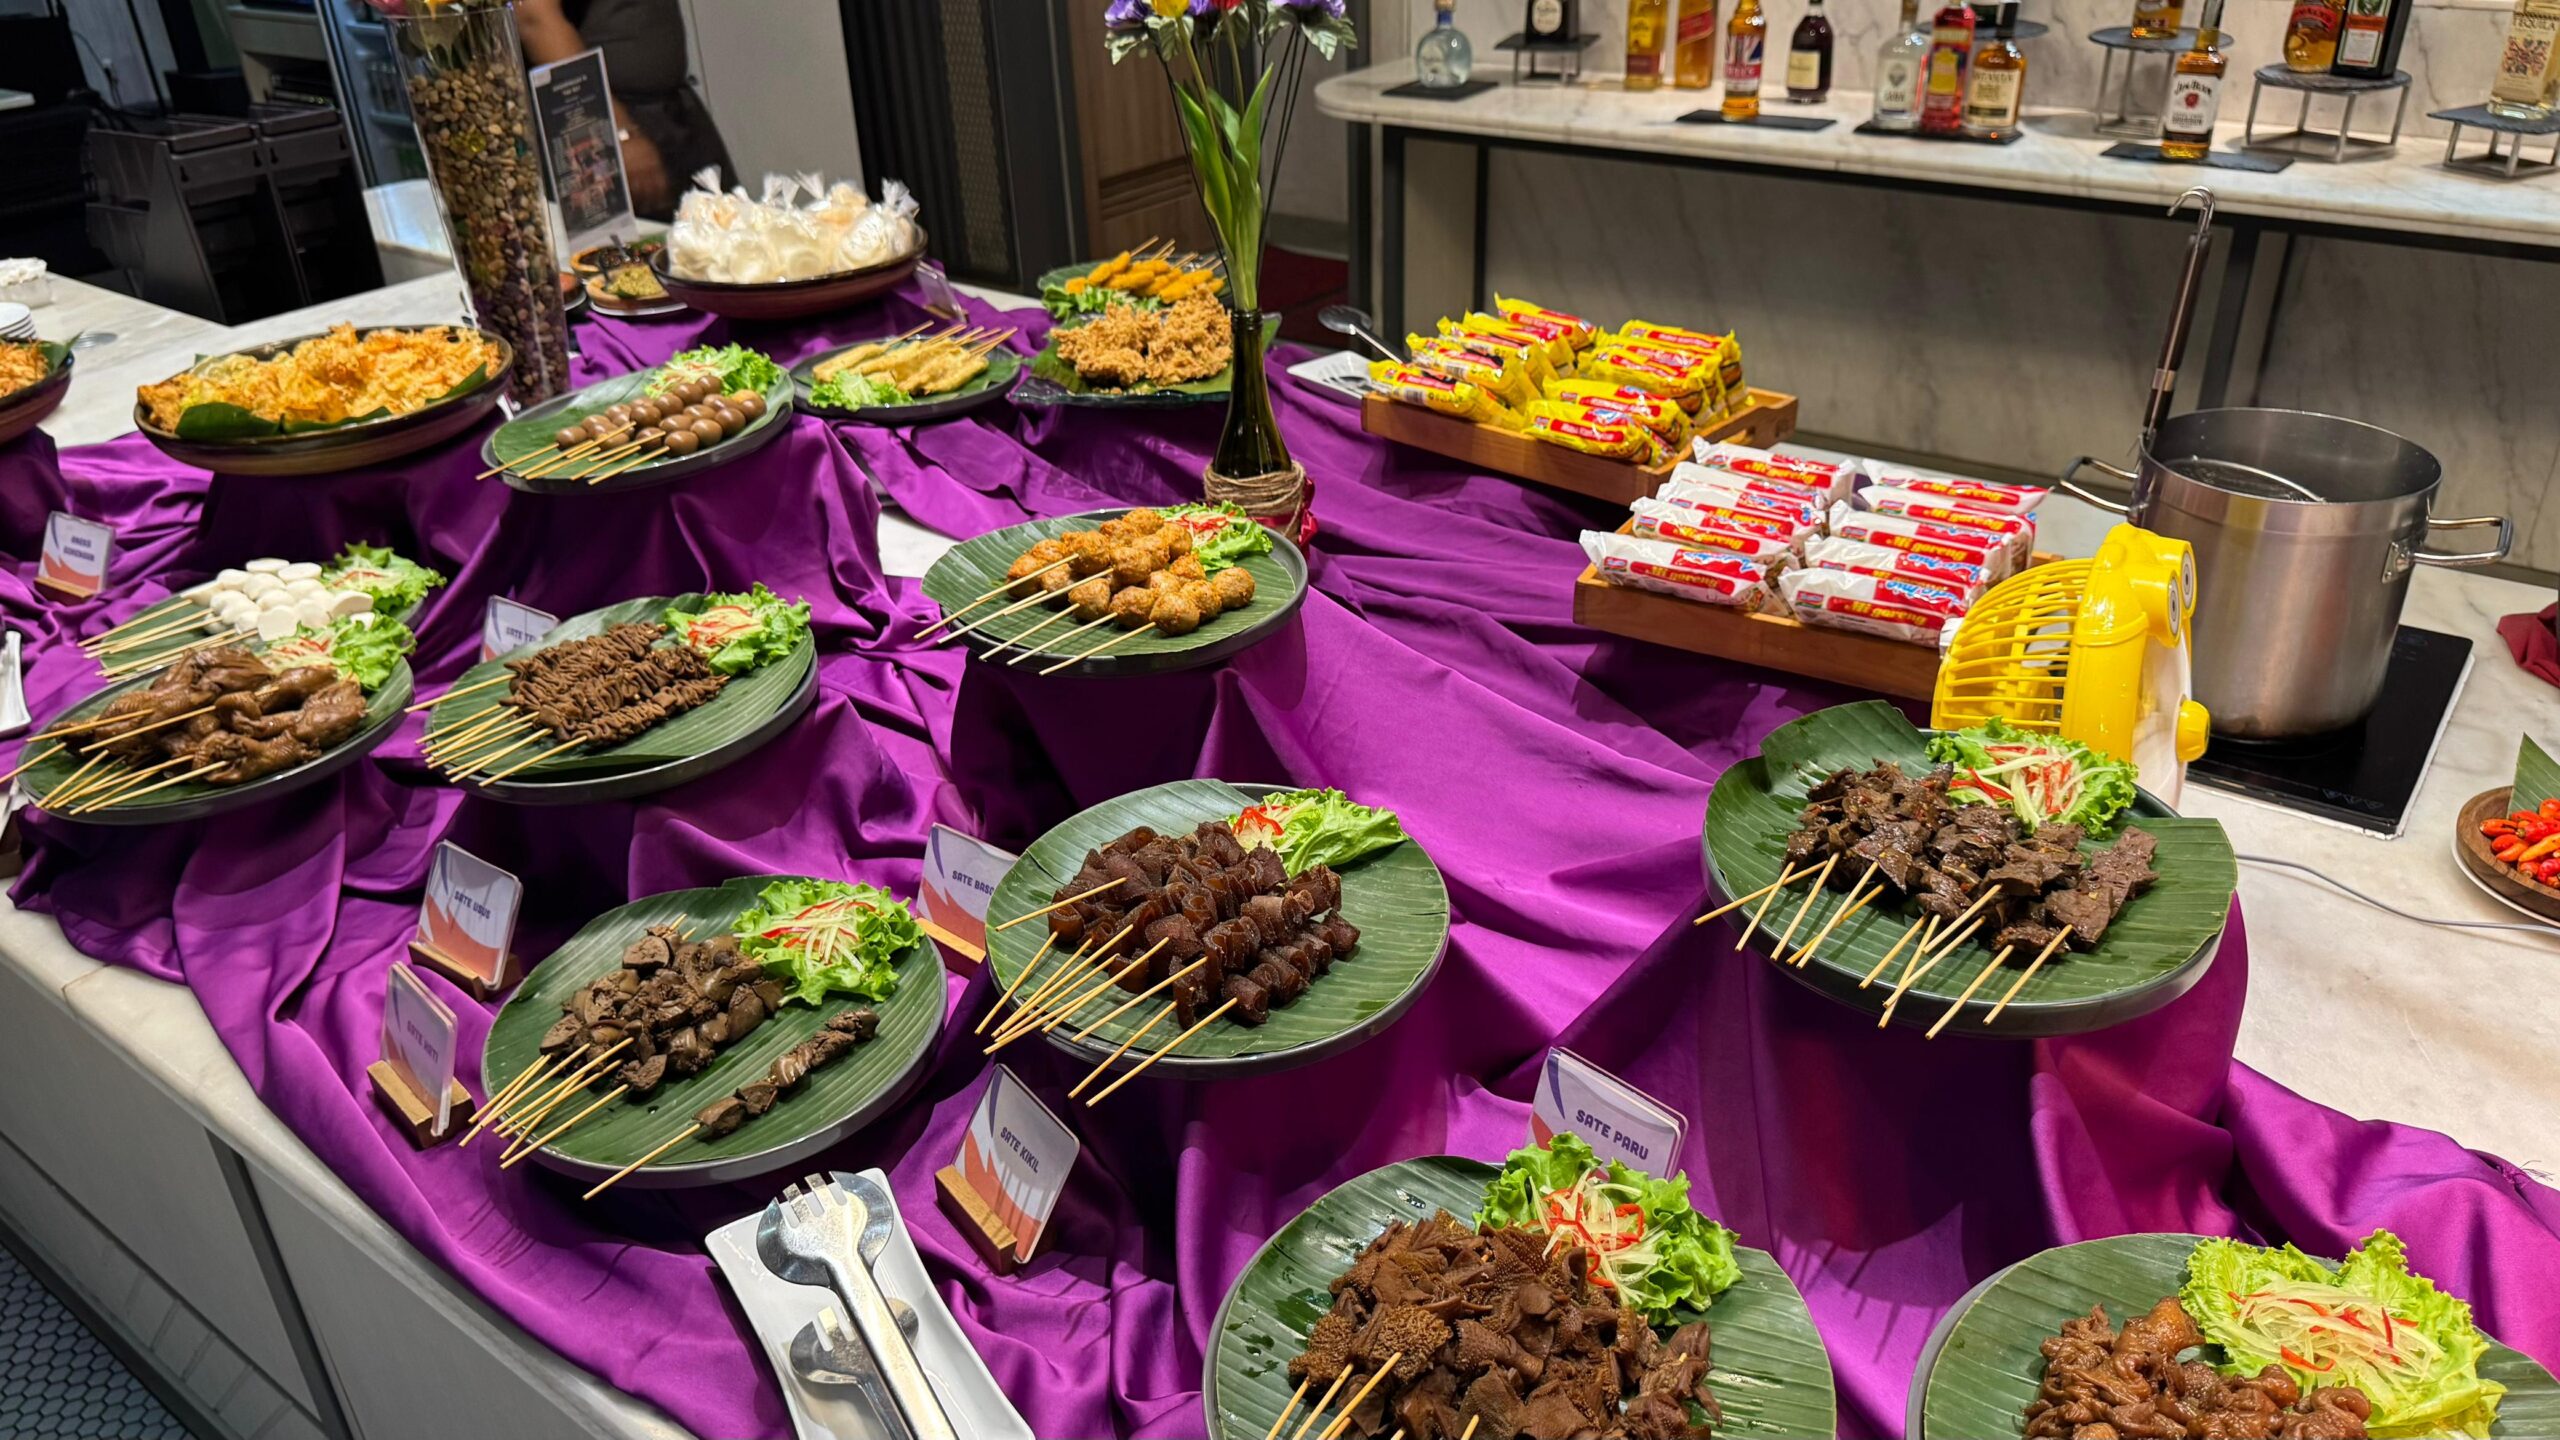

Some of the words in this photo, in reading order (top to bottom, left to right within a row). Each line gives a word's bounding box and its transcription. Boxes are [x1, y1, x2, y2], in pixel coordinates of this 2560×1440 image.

[953, 870, 973, 886] SATE
[455, 890, 473, 908] SATE
[473, 901, 491, 919] USUS
[1000, 1126, 1021, 1152] SATE
[1019, 1145, 1039, 1174] KIKIL
[1576, 1109, 1611, 1138] SATE
[1613, 1130, 1649, 1160] PARU
